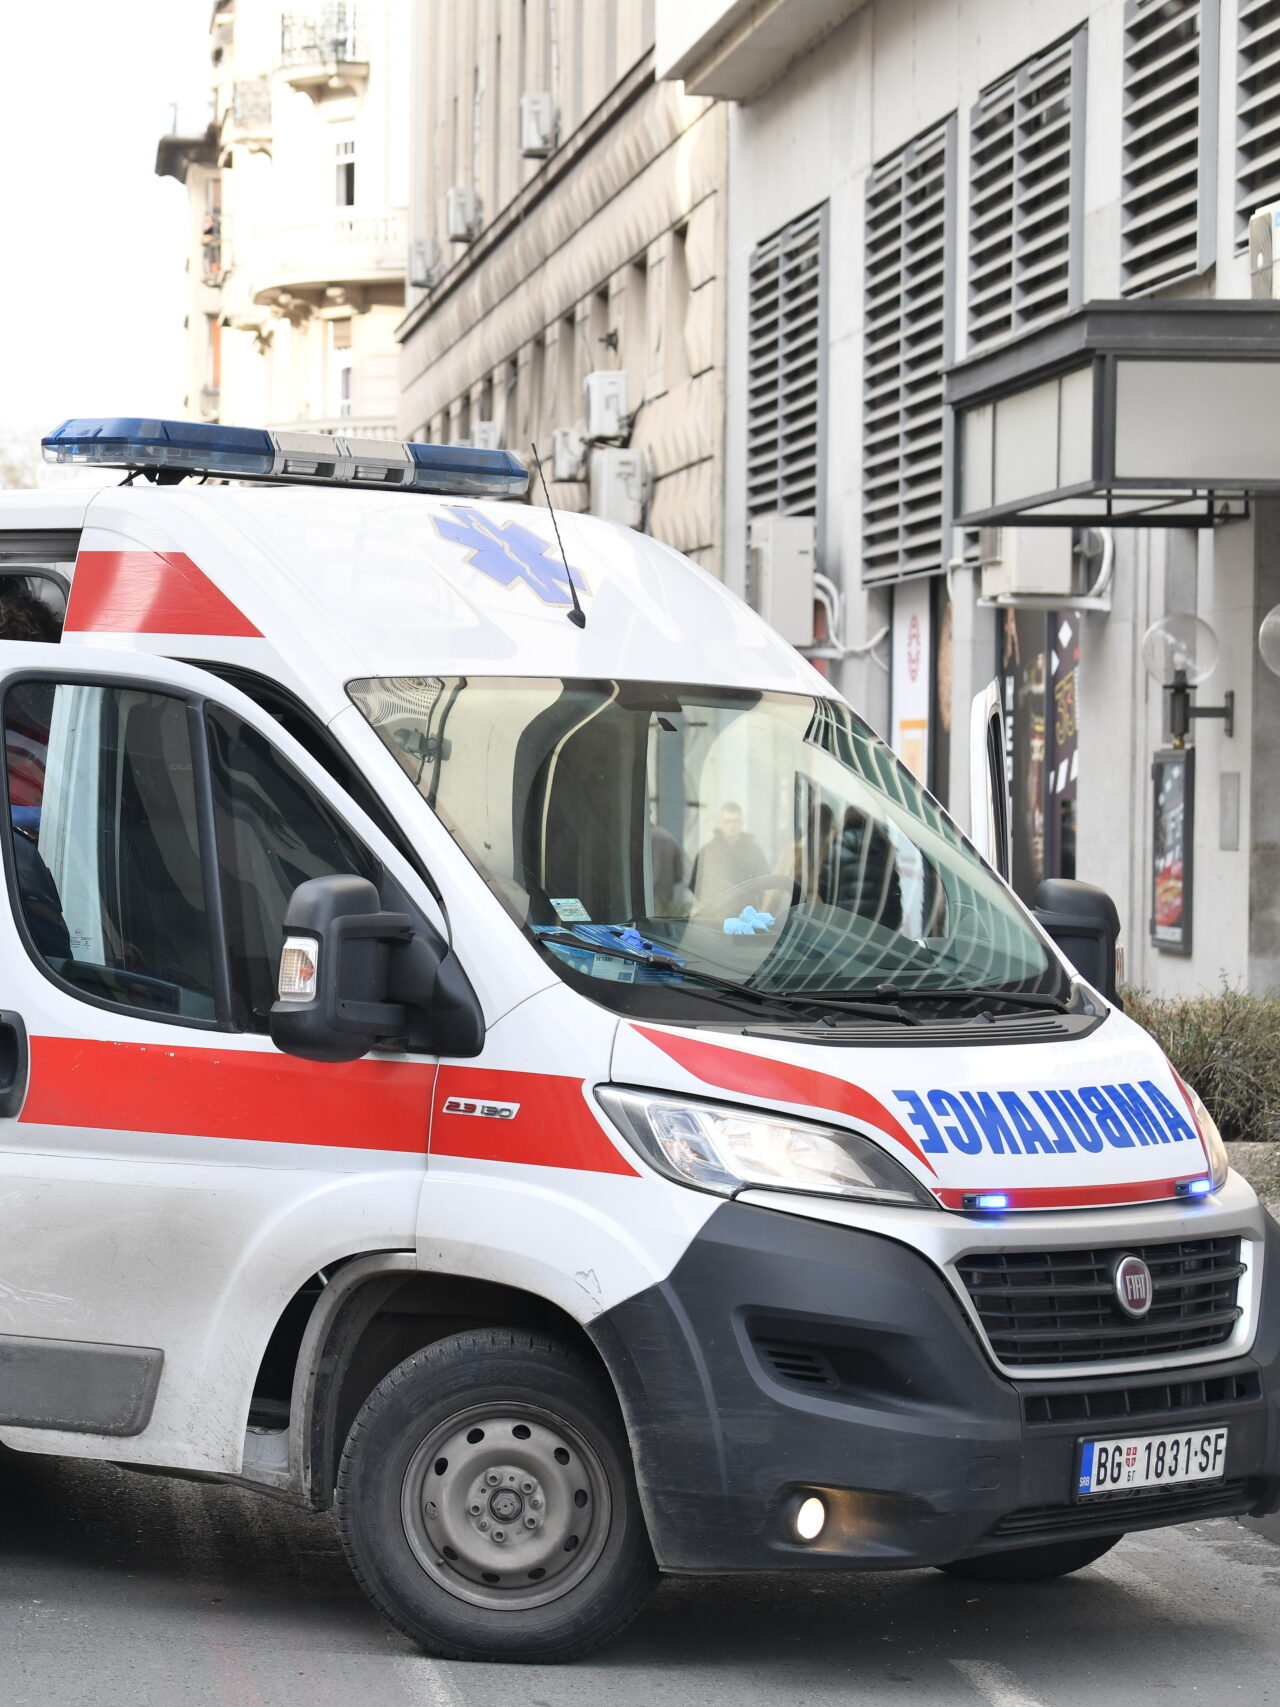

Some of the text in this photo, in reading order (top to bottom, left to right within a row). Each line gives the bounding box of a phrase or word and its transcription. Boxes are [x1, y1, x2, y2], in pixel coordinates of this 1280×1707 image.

[481, 1105, 513, 1118] 130
[1125, 1274, 1146, 1300] FIAT
[1096, 1445, 1122, 1486] BG
[1079, 1475, 1091, 1487] SRB
